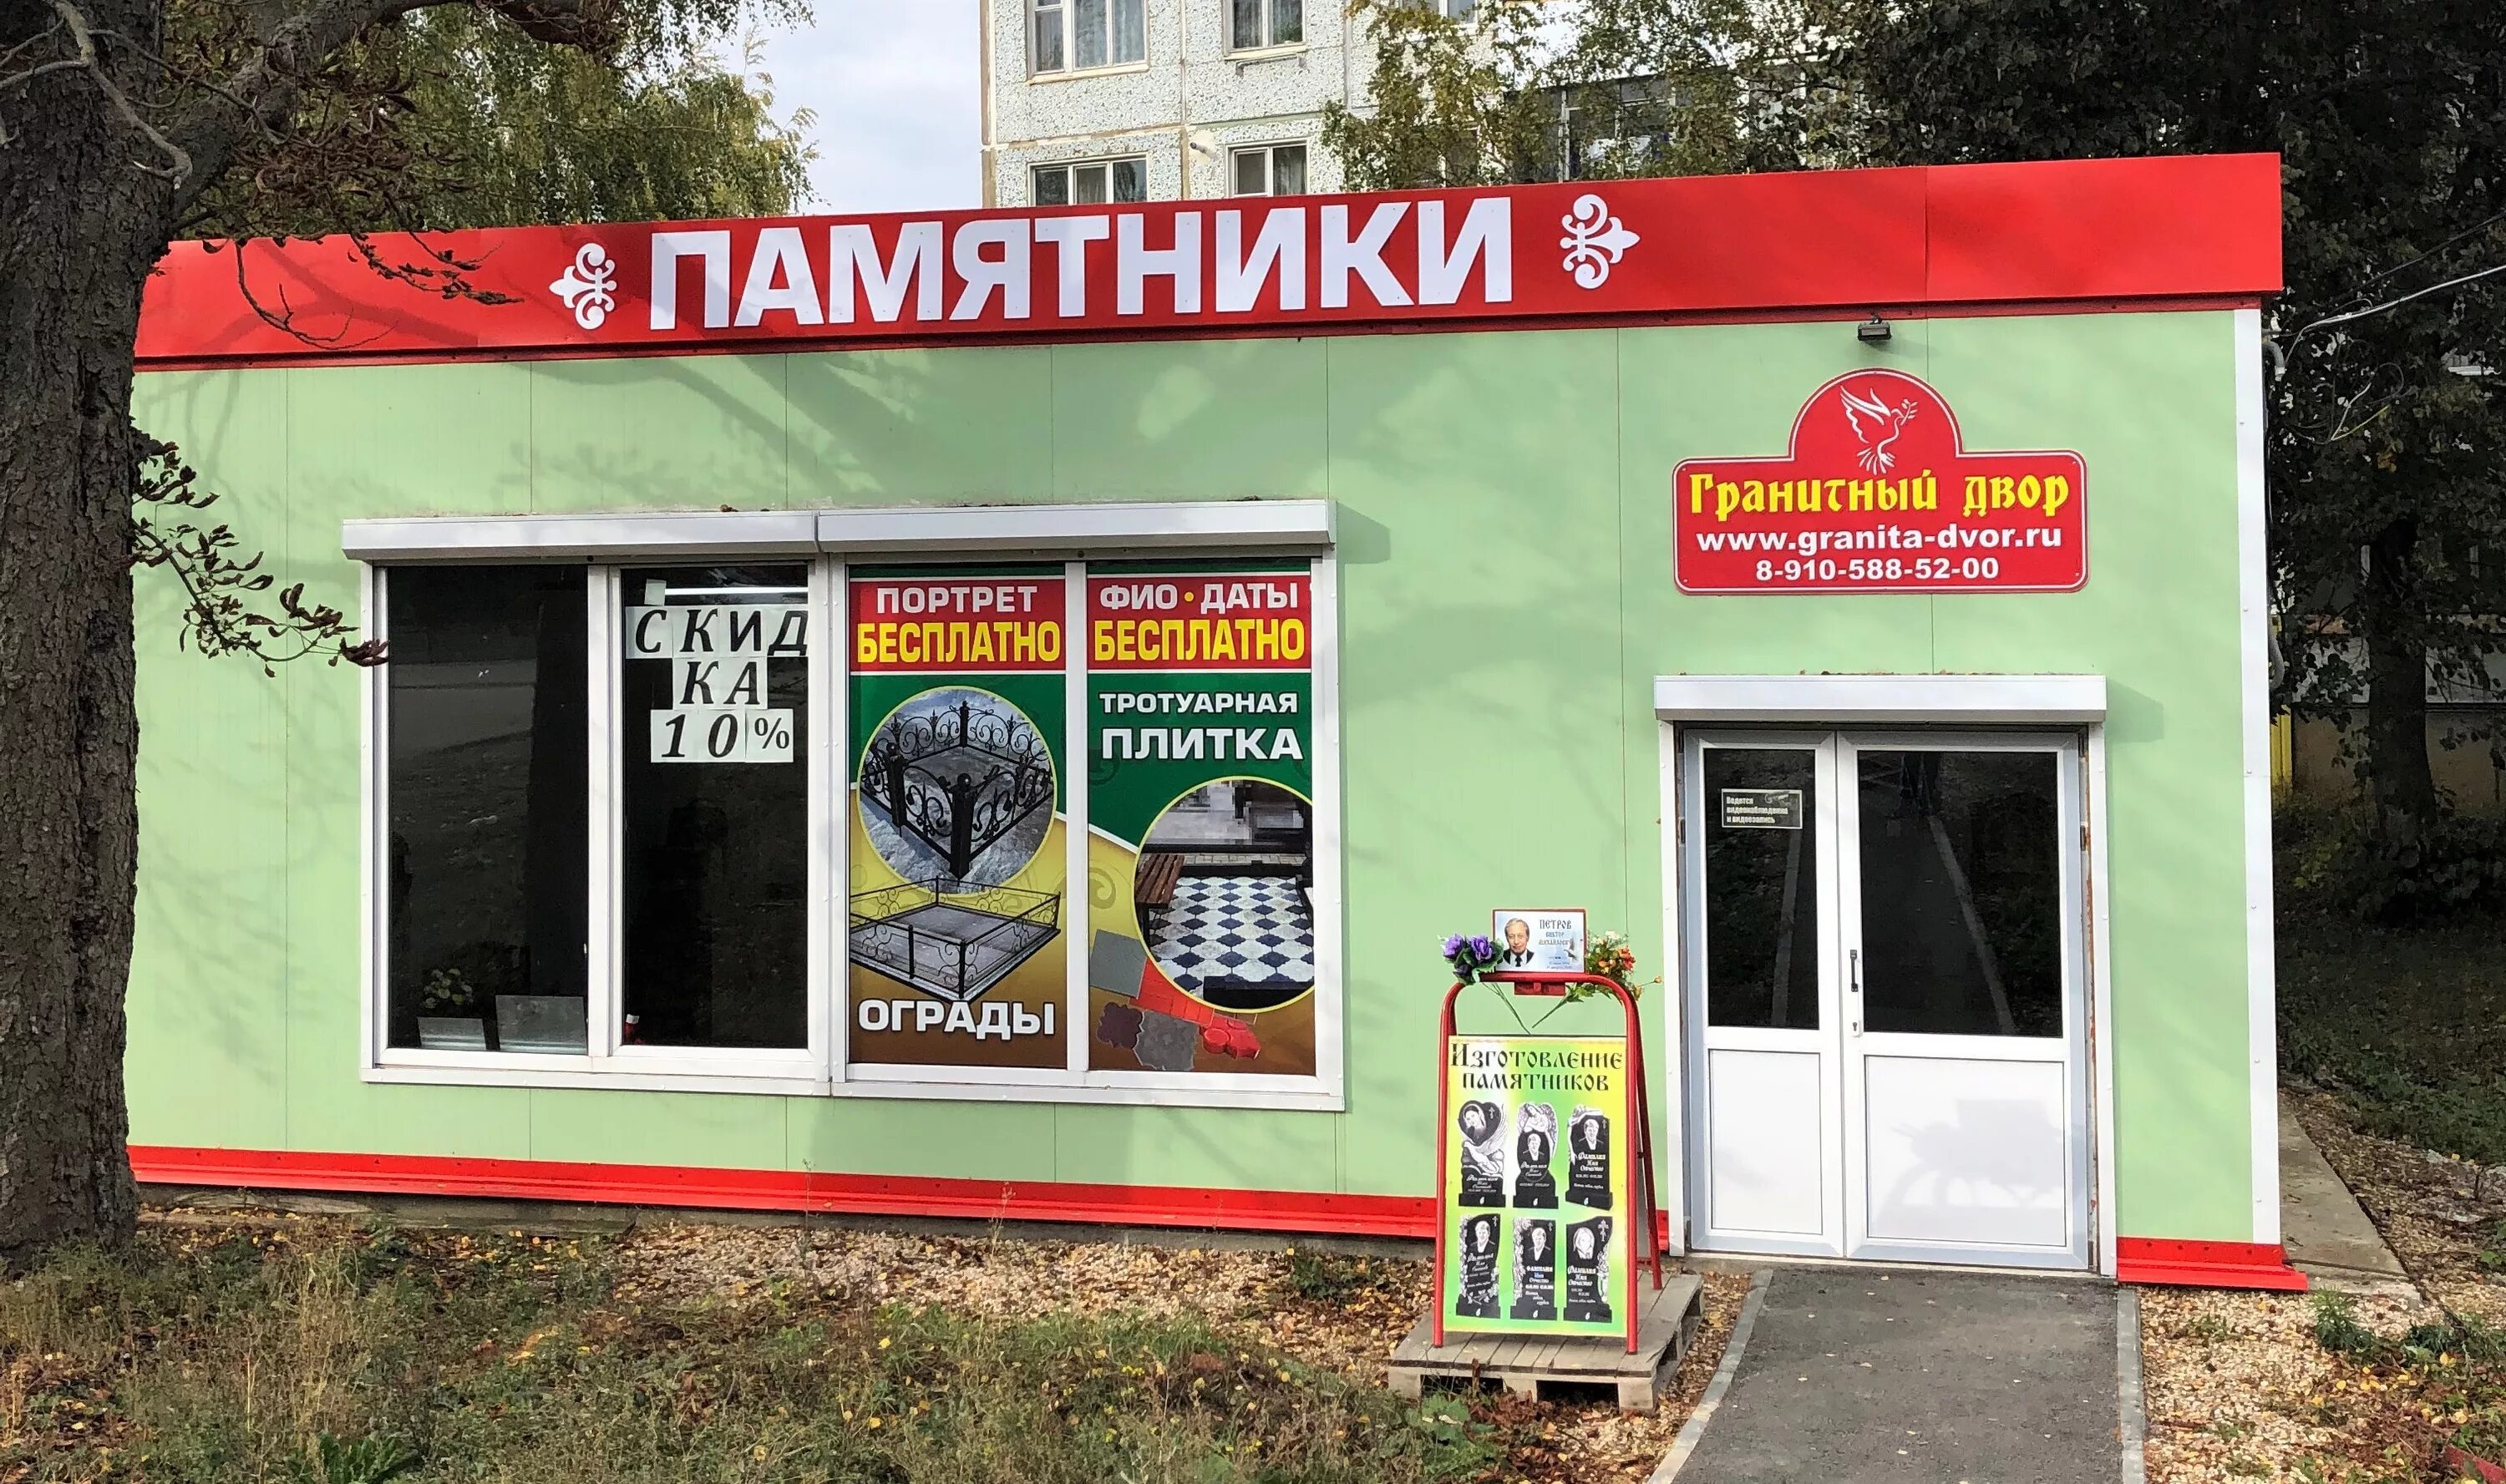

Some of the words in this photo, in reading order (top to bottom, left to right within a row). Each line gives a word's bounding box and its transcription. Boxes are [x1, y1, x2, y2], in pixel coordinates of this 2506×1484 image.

[650, 196, 1512, 330] ПАМЯТНИКИ
[1689, 468, 1938, 522] Гранитный
[1962, 474, 2070, 518] двор
[1696, 524, 2062, 556] www.granita-dvor.ru
[1755, 557, 2000, 580] 8-910-588-52-00
[876, 585, 1037, 614] ПОРТРЕТ
[1099, 584, 1179, 611] ФИО
[1200, 582, 1298, 615] ДАТЫ
[635, 608, 809, 656] СКИД
[856, 620, 1061, 663] БЕСПЛАТНО
[1093, 618, 1306, 661] БЕСПЛАТНО
[679, 661, 761, 705] КА
[1098, 692, 1298, 714] ТРОТУАРНАЯ
[1101, 727, 1304, 761] ПЛИТКА
[1539, 919, 1572, 929] ПЕТРОВ
[858, 1000, 1055, 1041] ОГРАДЫ
